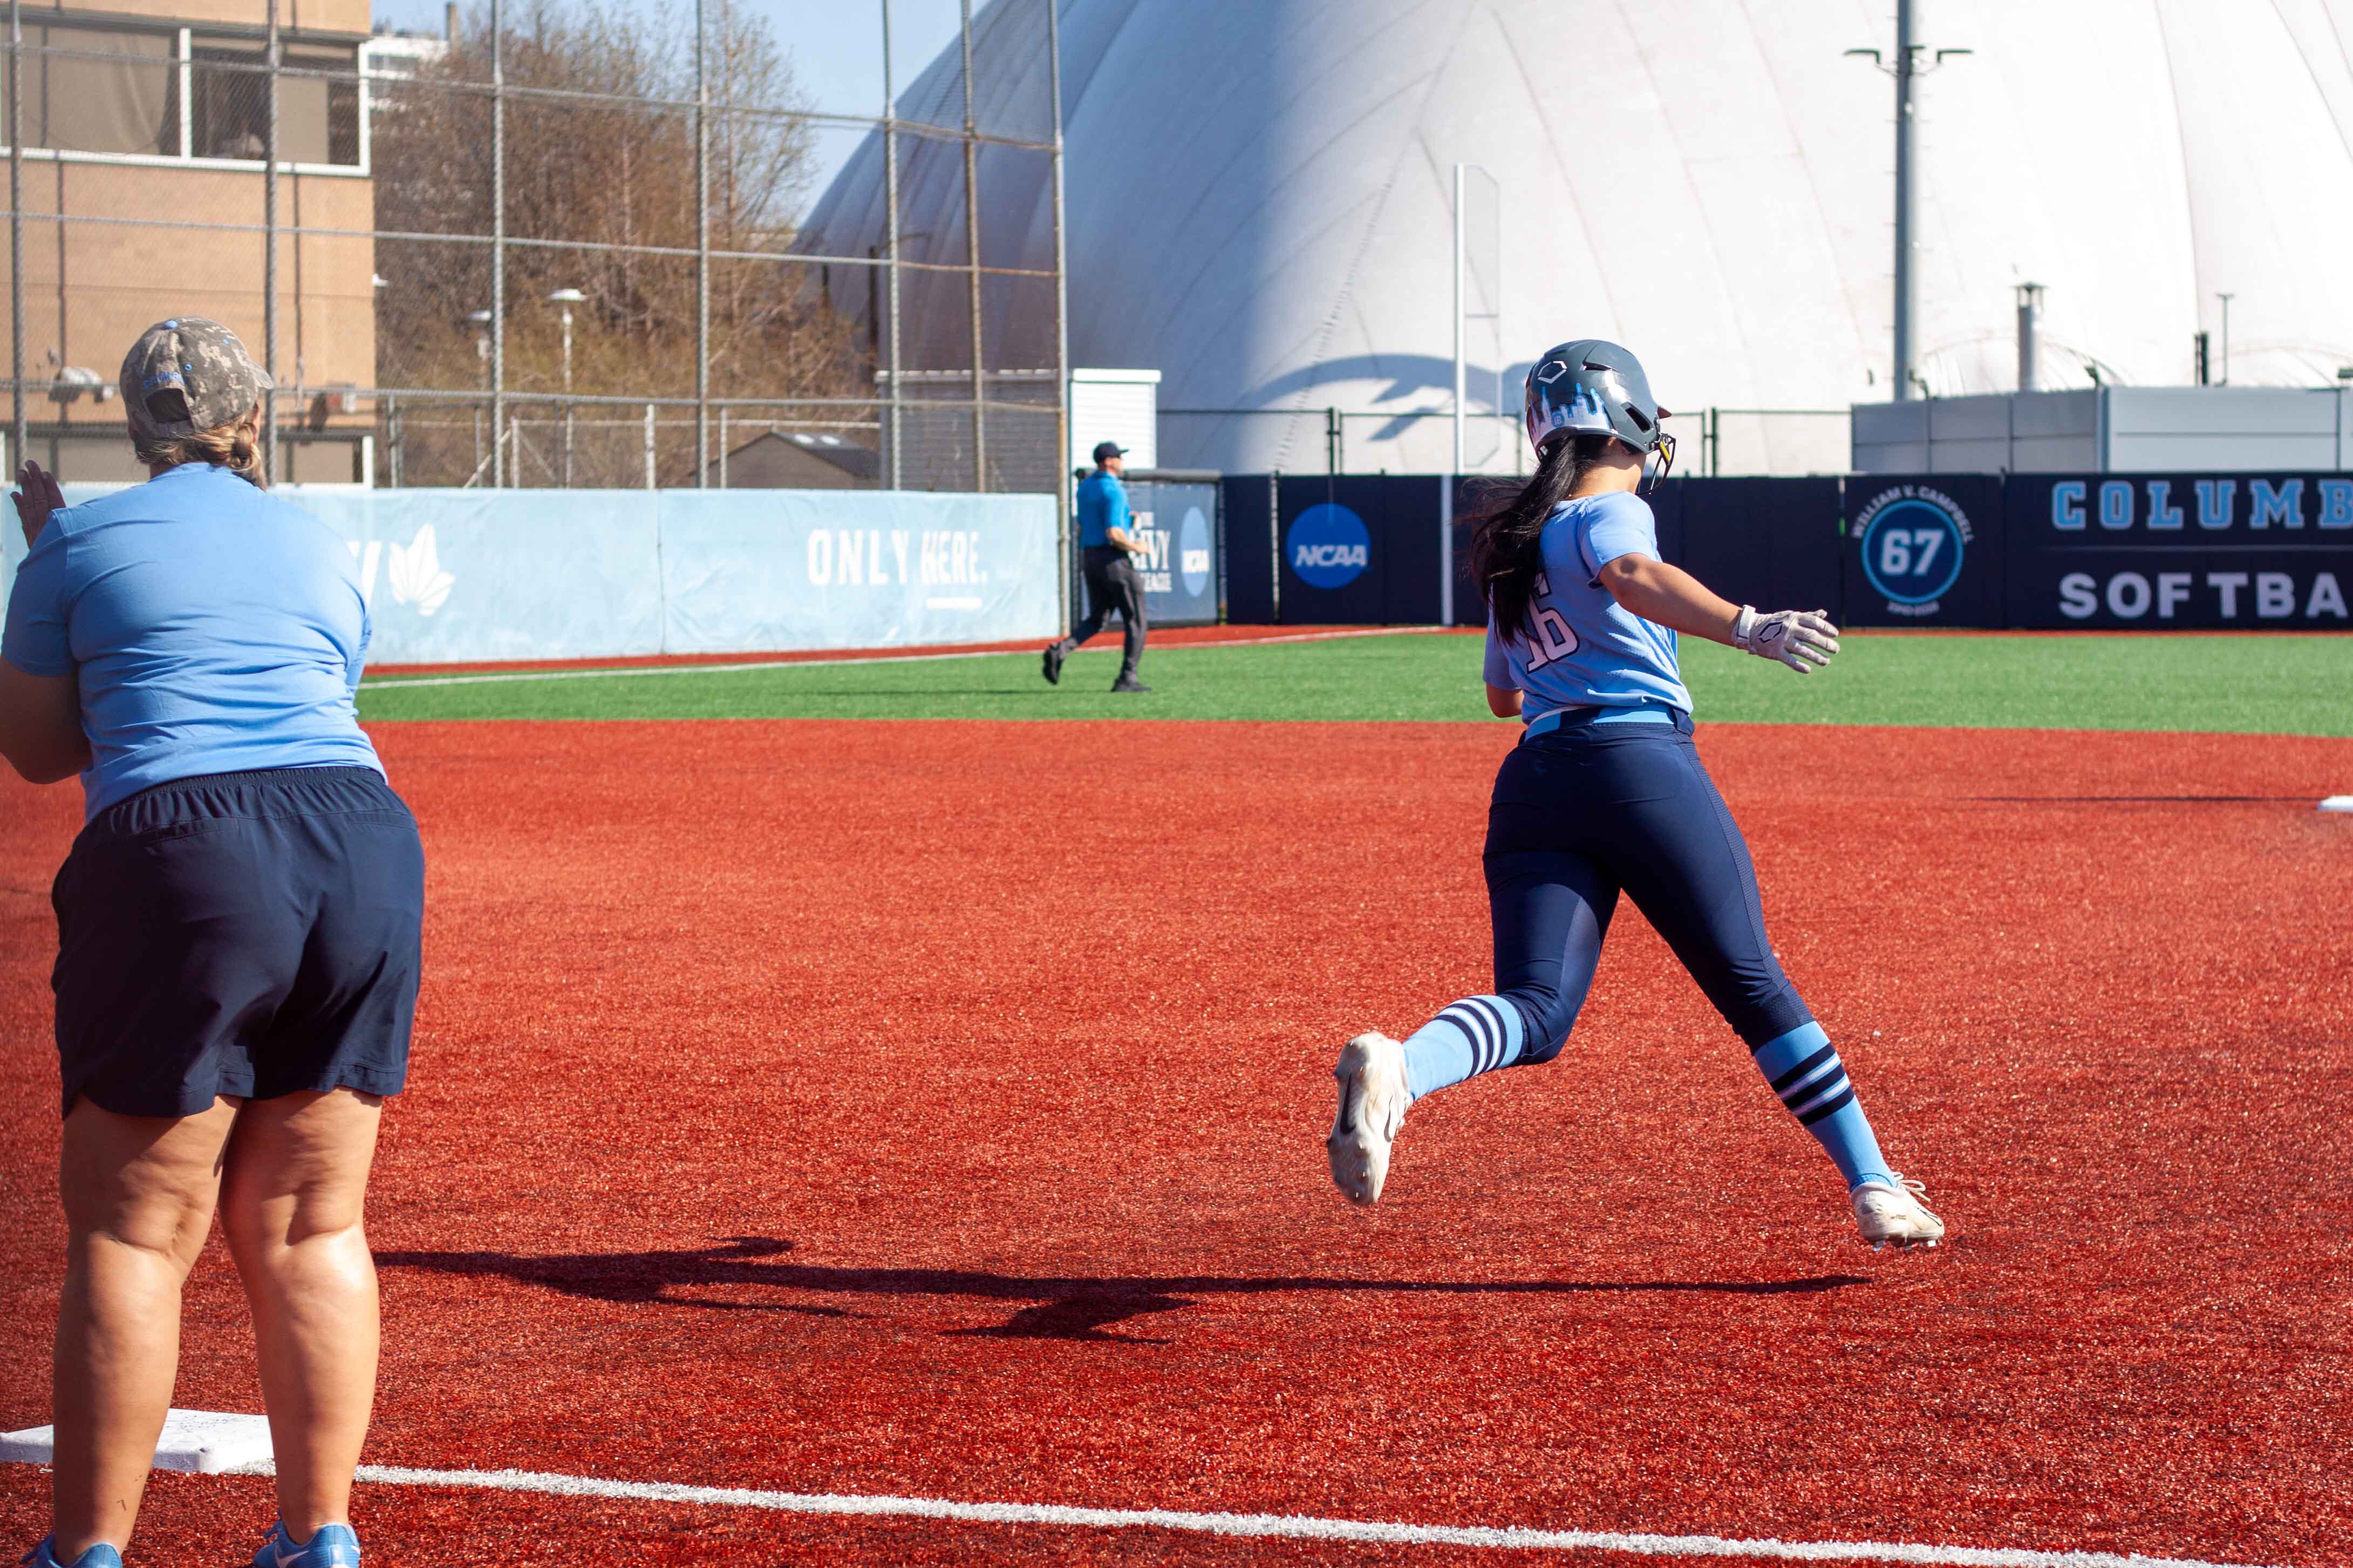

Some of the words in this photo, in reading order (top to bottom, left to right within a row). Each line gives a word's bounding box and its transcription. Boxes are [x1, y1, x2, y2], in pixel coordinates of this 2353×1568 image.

[2052, 480, 2353, 529] COLUMB
[808, 529, 910, 586] ONLY
[919, 531, 988, 585] HERE.
[1296, 544, 1367, 567] NCAA
[1881, 529, 1944, 576] 67
[2059, 572, 2348, 619] SOFTBA
[1527, 571, 1580, 674] 6
